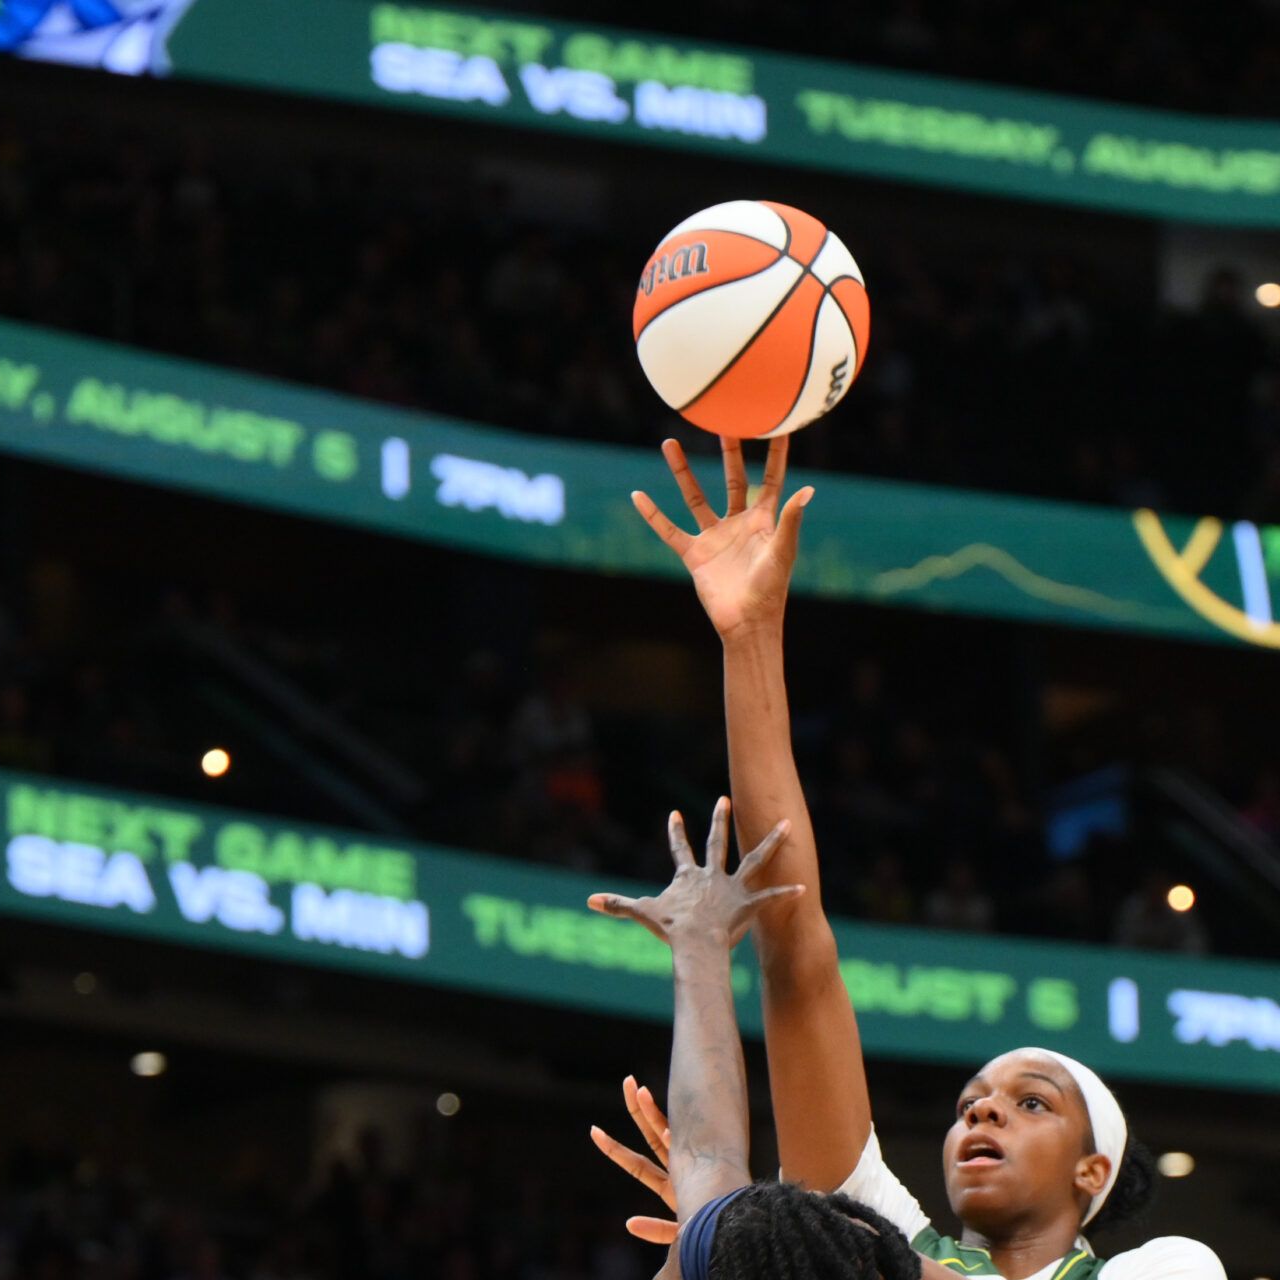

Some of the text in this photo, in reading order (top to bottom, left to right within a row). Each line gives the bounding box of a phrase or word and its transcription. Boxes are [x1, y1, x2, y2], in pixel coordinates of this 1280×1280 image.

[369, 42, 767, 143] SEA VS. MIN
[371, 3, 754, 92] NEXT GAME
[67, 377, 306, 468] AUGUST
[429, 453, 566, 526] 7PM
[5, 834, 430, 959] SEA VS. MIN
[7, 784, 417, 900] NEXT GAME
